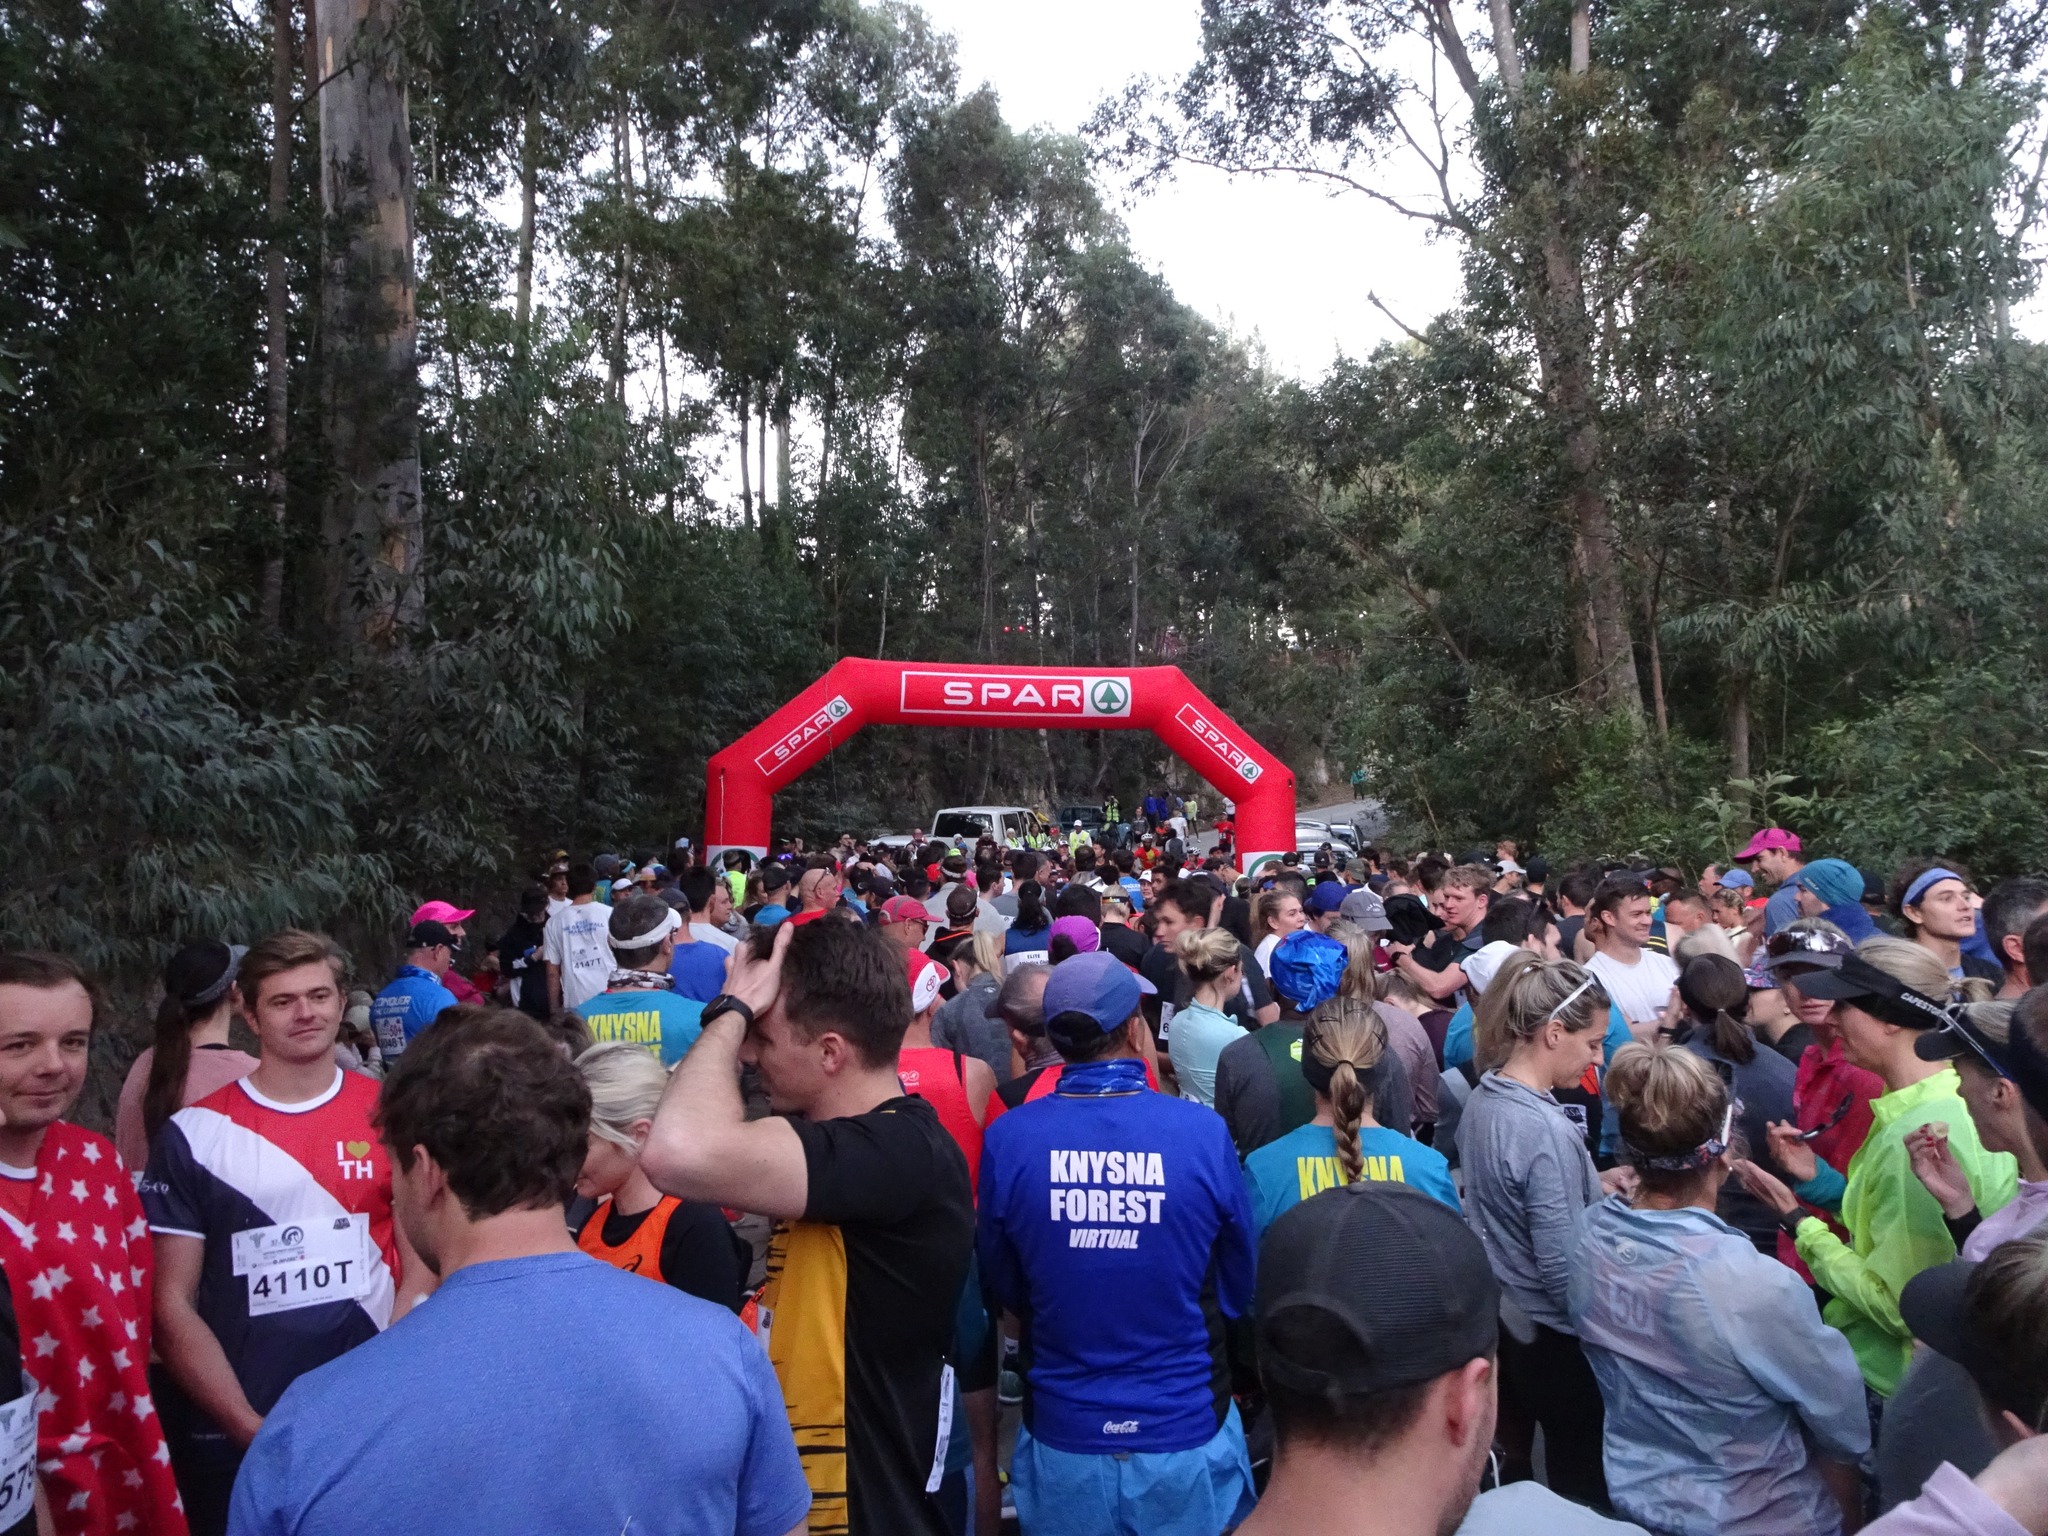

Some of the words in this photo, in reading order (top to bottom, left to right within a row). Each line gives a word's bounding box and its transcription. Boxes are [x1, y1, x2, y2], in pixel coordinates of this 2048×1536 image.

[944, 681, 1081, 708] SPAR
[774, 714, 831, 760] SPAR
[1192, 719, 1243, 766] SPAR
[336, 1140, 345, 1160] I
[337, 1160, 373, 1180] TH
[1049, 1150, 1165, 1186] KNYSNA
[1049, 1188, 1166, 1224] FOREST
[1068, 1228, 1140, 1249] VIRTUAL
[252, 1259, 354, 1298] 4110T
[1102, 1420, 1141, 1434] Coca-Cola
